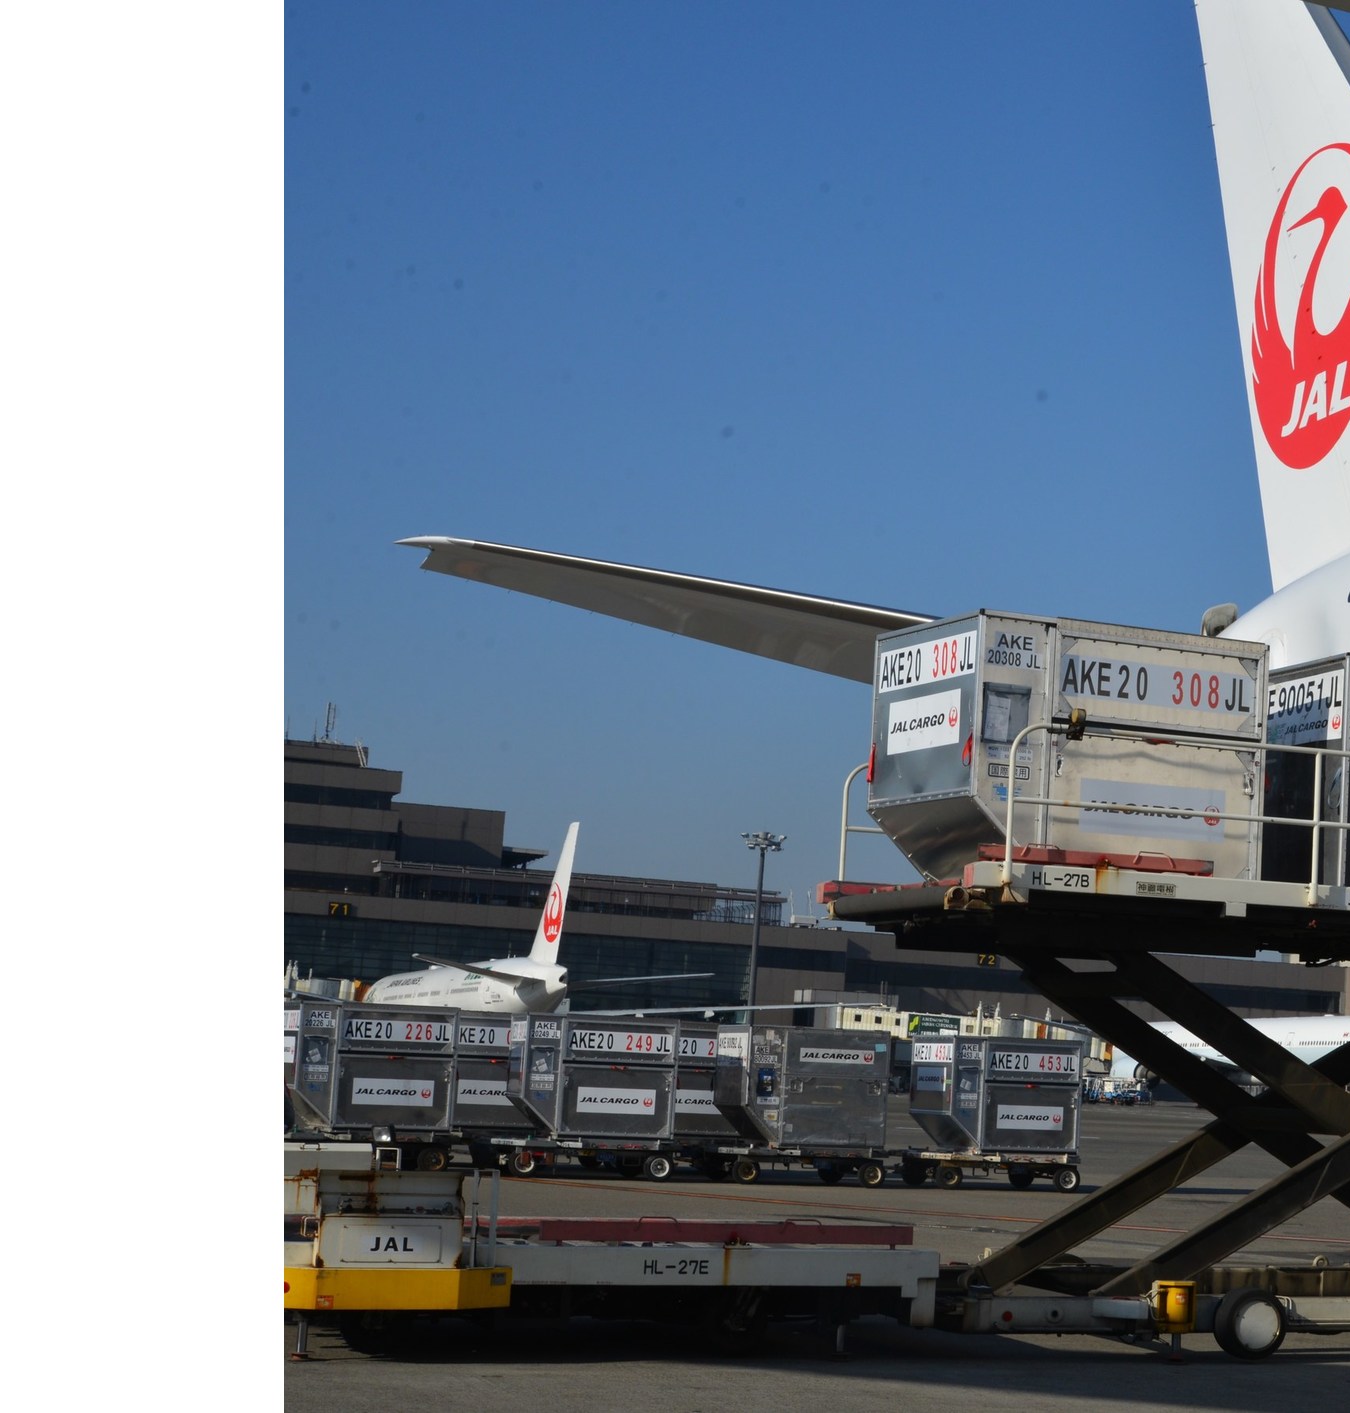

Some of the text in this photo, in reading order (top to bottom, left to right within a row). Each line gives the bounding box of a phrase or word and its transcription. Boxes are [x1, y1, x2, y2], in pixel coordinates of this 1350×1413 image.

[998, 634, 1033, 651] AKE
[988, 649, 1040, 669] 20308 JL
[881, 648, 921, 689] AKE20
[1062, 658, 1148, 701] AKE20
[1032, 872, 1090, 888] HL-27B
[330, 903, 348, 916] 71
[979, 954, 995, 965] 72
[310, 1011, 330, 1019] AKE
[345, 1021, 393, 1039] AKE20
[537, 1022, 556, 1030] AKE
[569, 1032, 614, 1050] AKE20
[679, 1039, 697, 1055] 20
[990, 1053, 1029, 1070] AKE20
[370, 1236, 414, 1252] JAL
[643, 1260, 709, 1275] HL-27E
